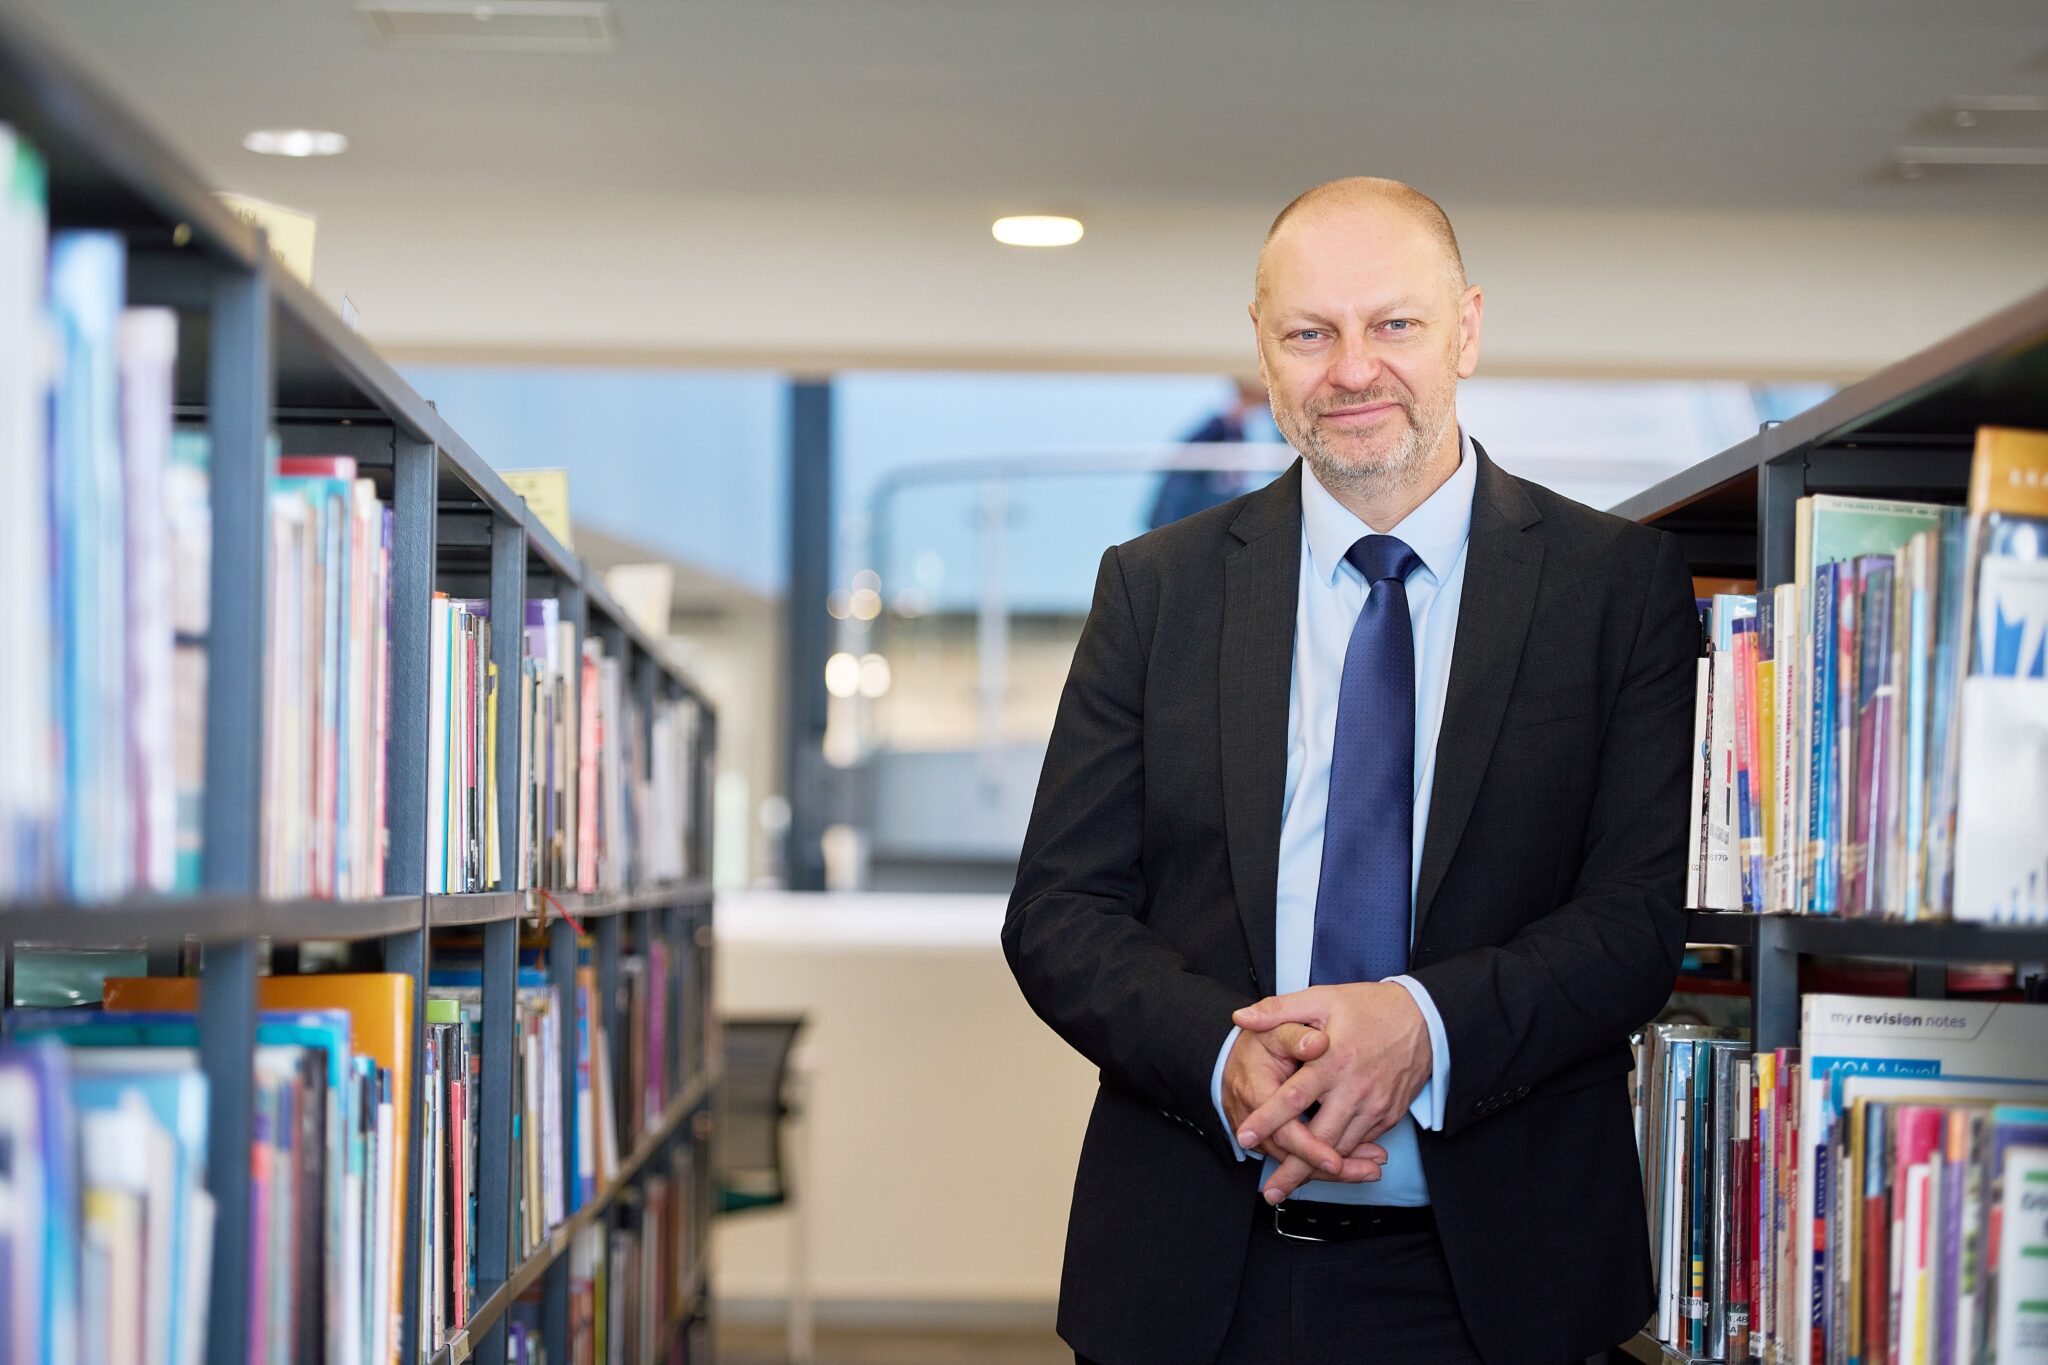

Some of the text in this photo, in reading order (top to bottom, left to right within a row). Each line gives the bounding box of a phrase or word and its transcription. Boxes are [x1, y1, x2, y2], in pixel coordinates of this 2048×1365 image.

[1816, 574, 1828, 659] COMPANY
[1814, 665, 1823, 703] LAW
[1813, 709, 1822, 747] FOR
[1831, 1012, 1967, 1028] my revision notes
